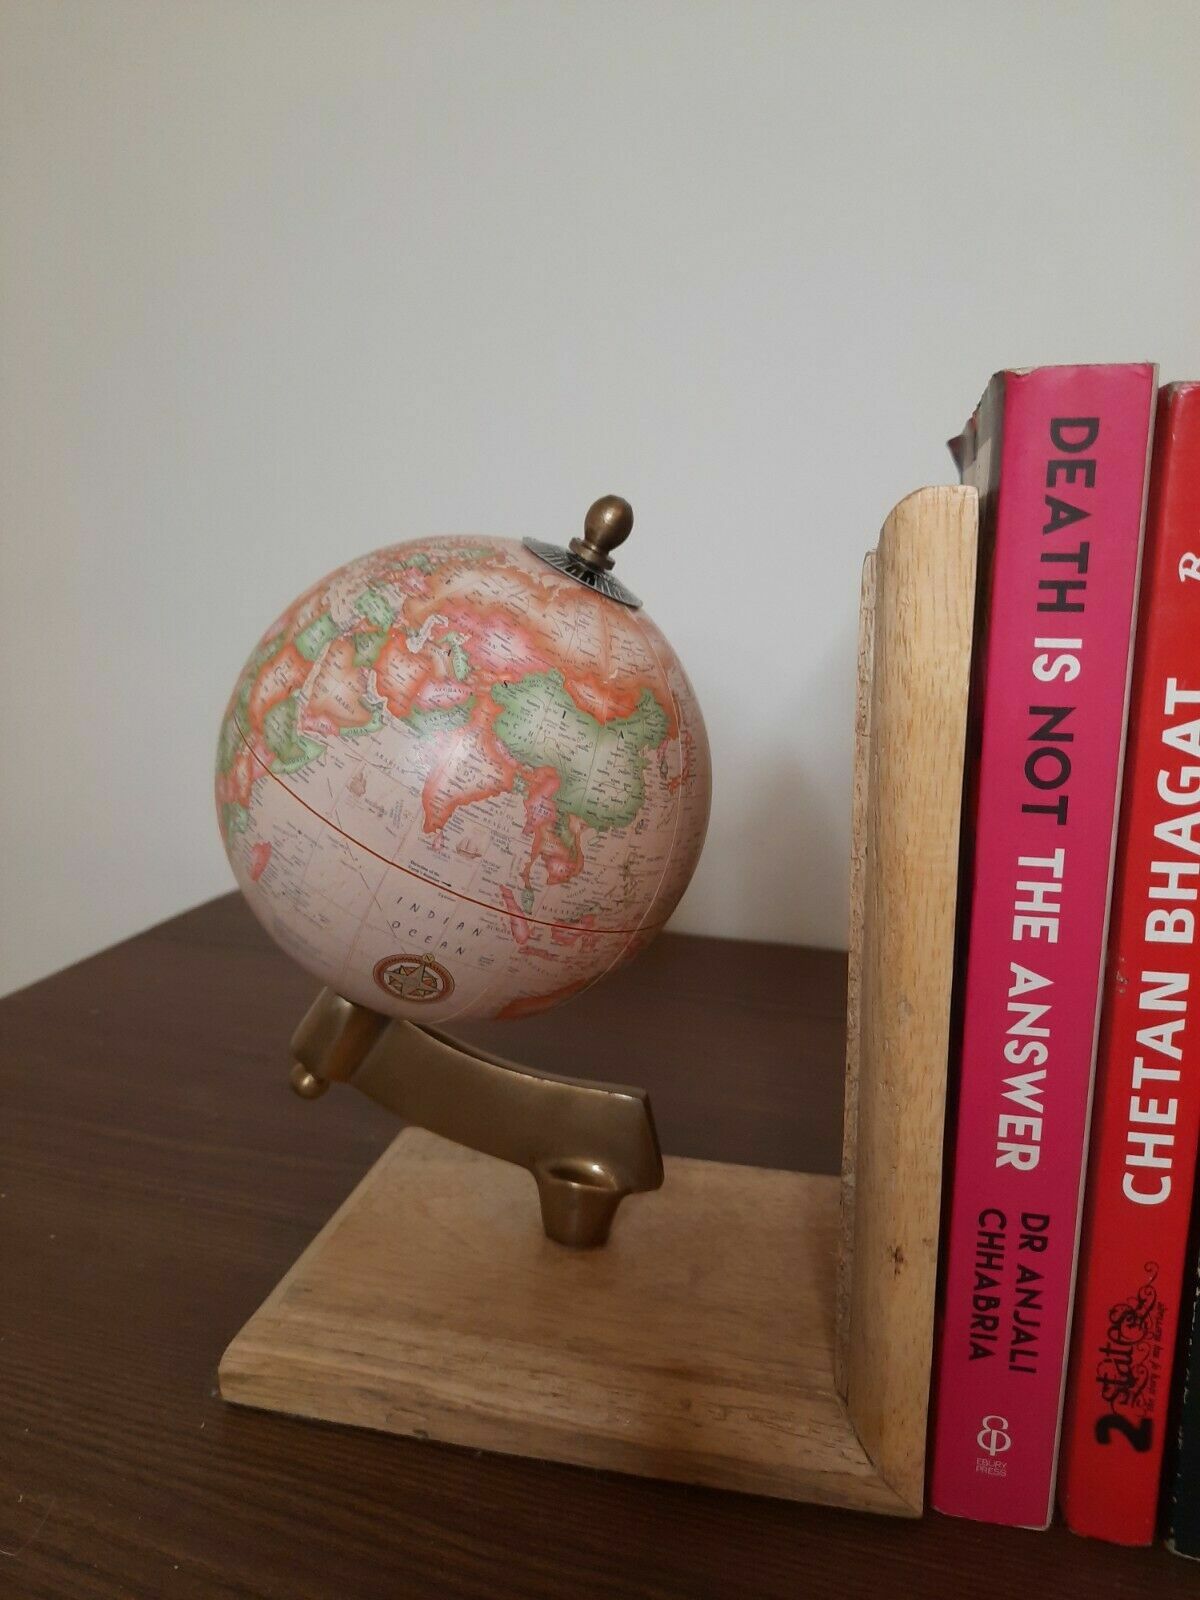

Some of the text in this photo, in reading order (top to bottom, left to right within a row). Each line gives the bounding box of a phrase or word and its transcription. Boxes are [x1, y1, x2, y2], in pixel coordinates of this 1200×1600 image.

[995, 416, 1100, 1172] DEATH IS NOT THE ANSWER
[391, 920, 466, 956] OCEAN
[396, 896, 483, 937] INDIAN
[1122, 677, 1200, 1205] CHETAN BHAGAT
[968, 1207, 1008, 1362] CHHABRIA
[1008, 1211, 1050, 1375] DR ANJALI
[975, 1465, 1008, 1477] PRESS
[1094, 1413, 1154, 1453] 2
